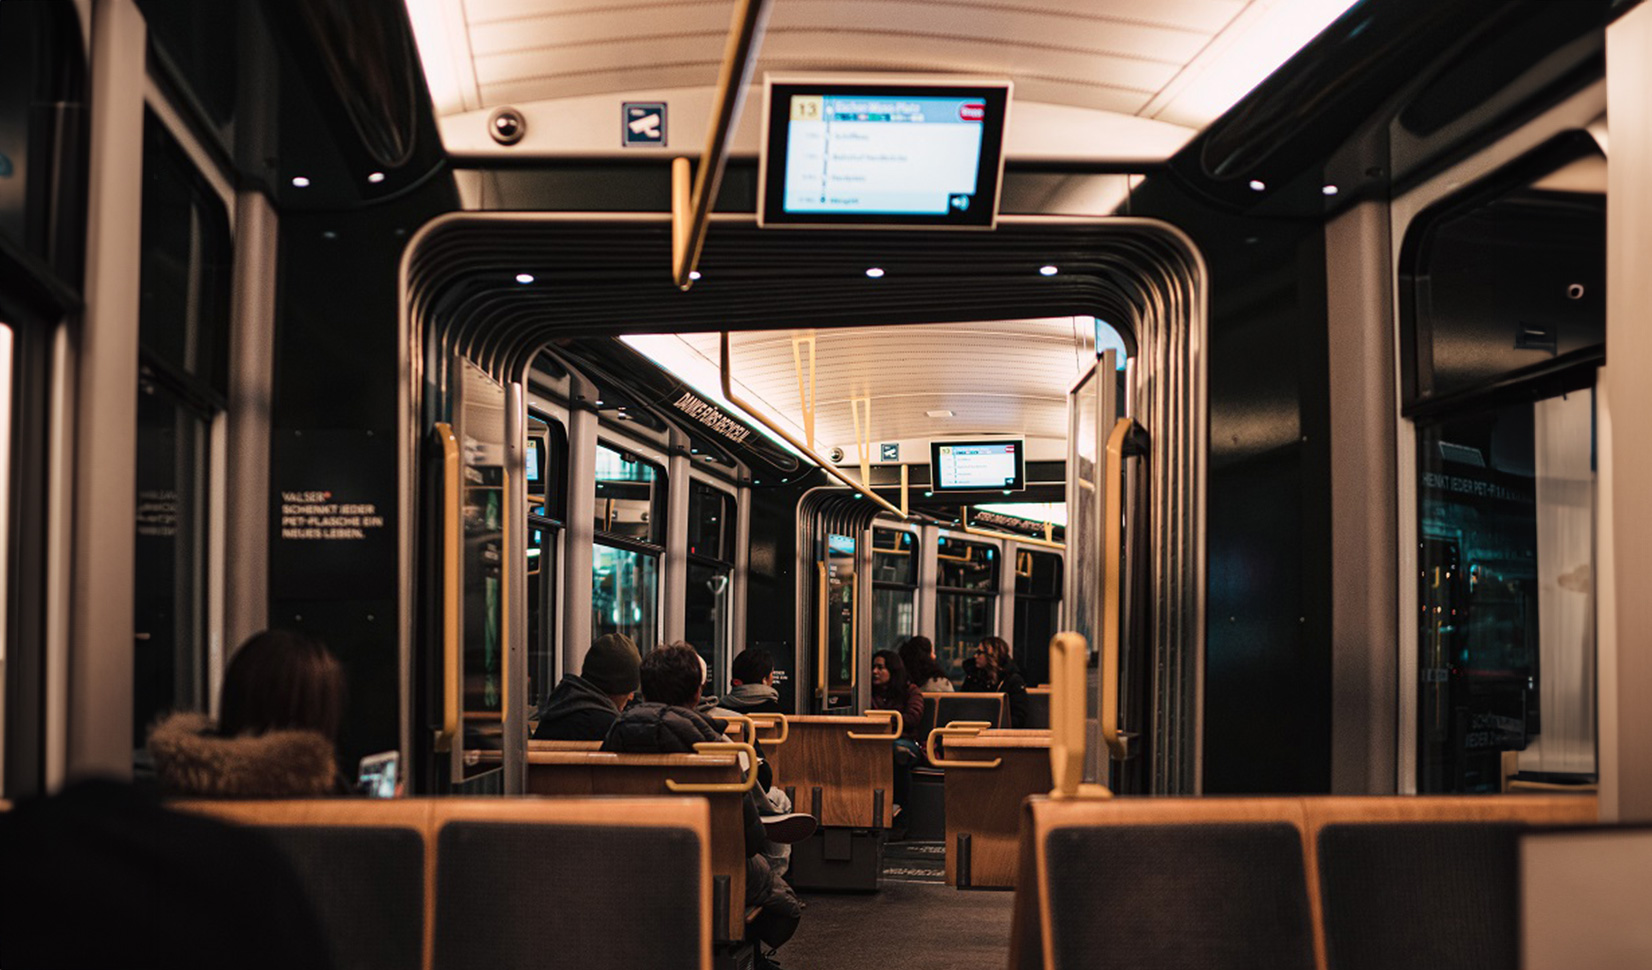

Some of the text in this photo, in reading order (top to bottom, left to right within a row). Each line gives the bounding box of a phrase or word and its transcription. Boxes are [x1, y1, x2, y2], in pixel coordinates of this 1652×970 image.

[798, 102, 817, 117] 13
[673, 391, 709, 419] DANKE
[282, 491, 326, 502] VALSER
[282, 504, 375, 515] SCHENKT JEDER
[282, 516, 384, 527] PET-FLASCHE EIN
[282, 528, 321, 539] NEUES
